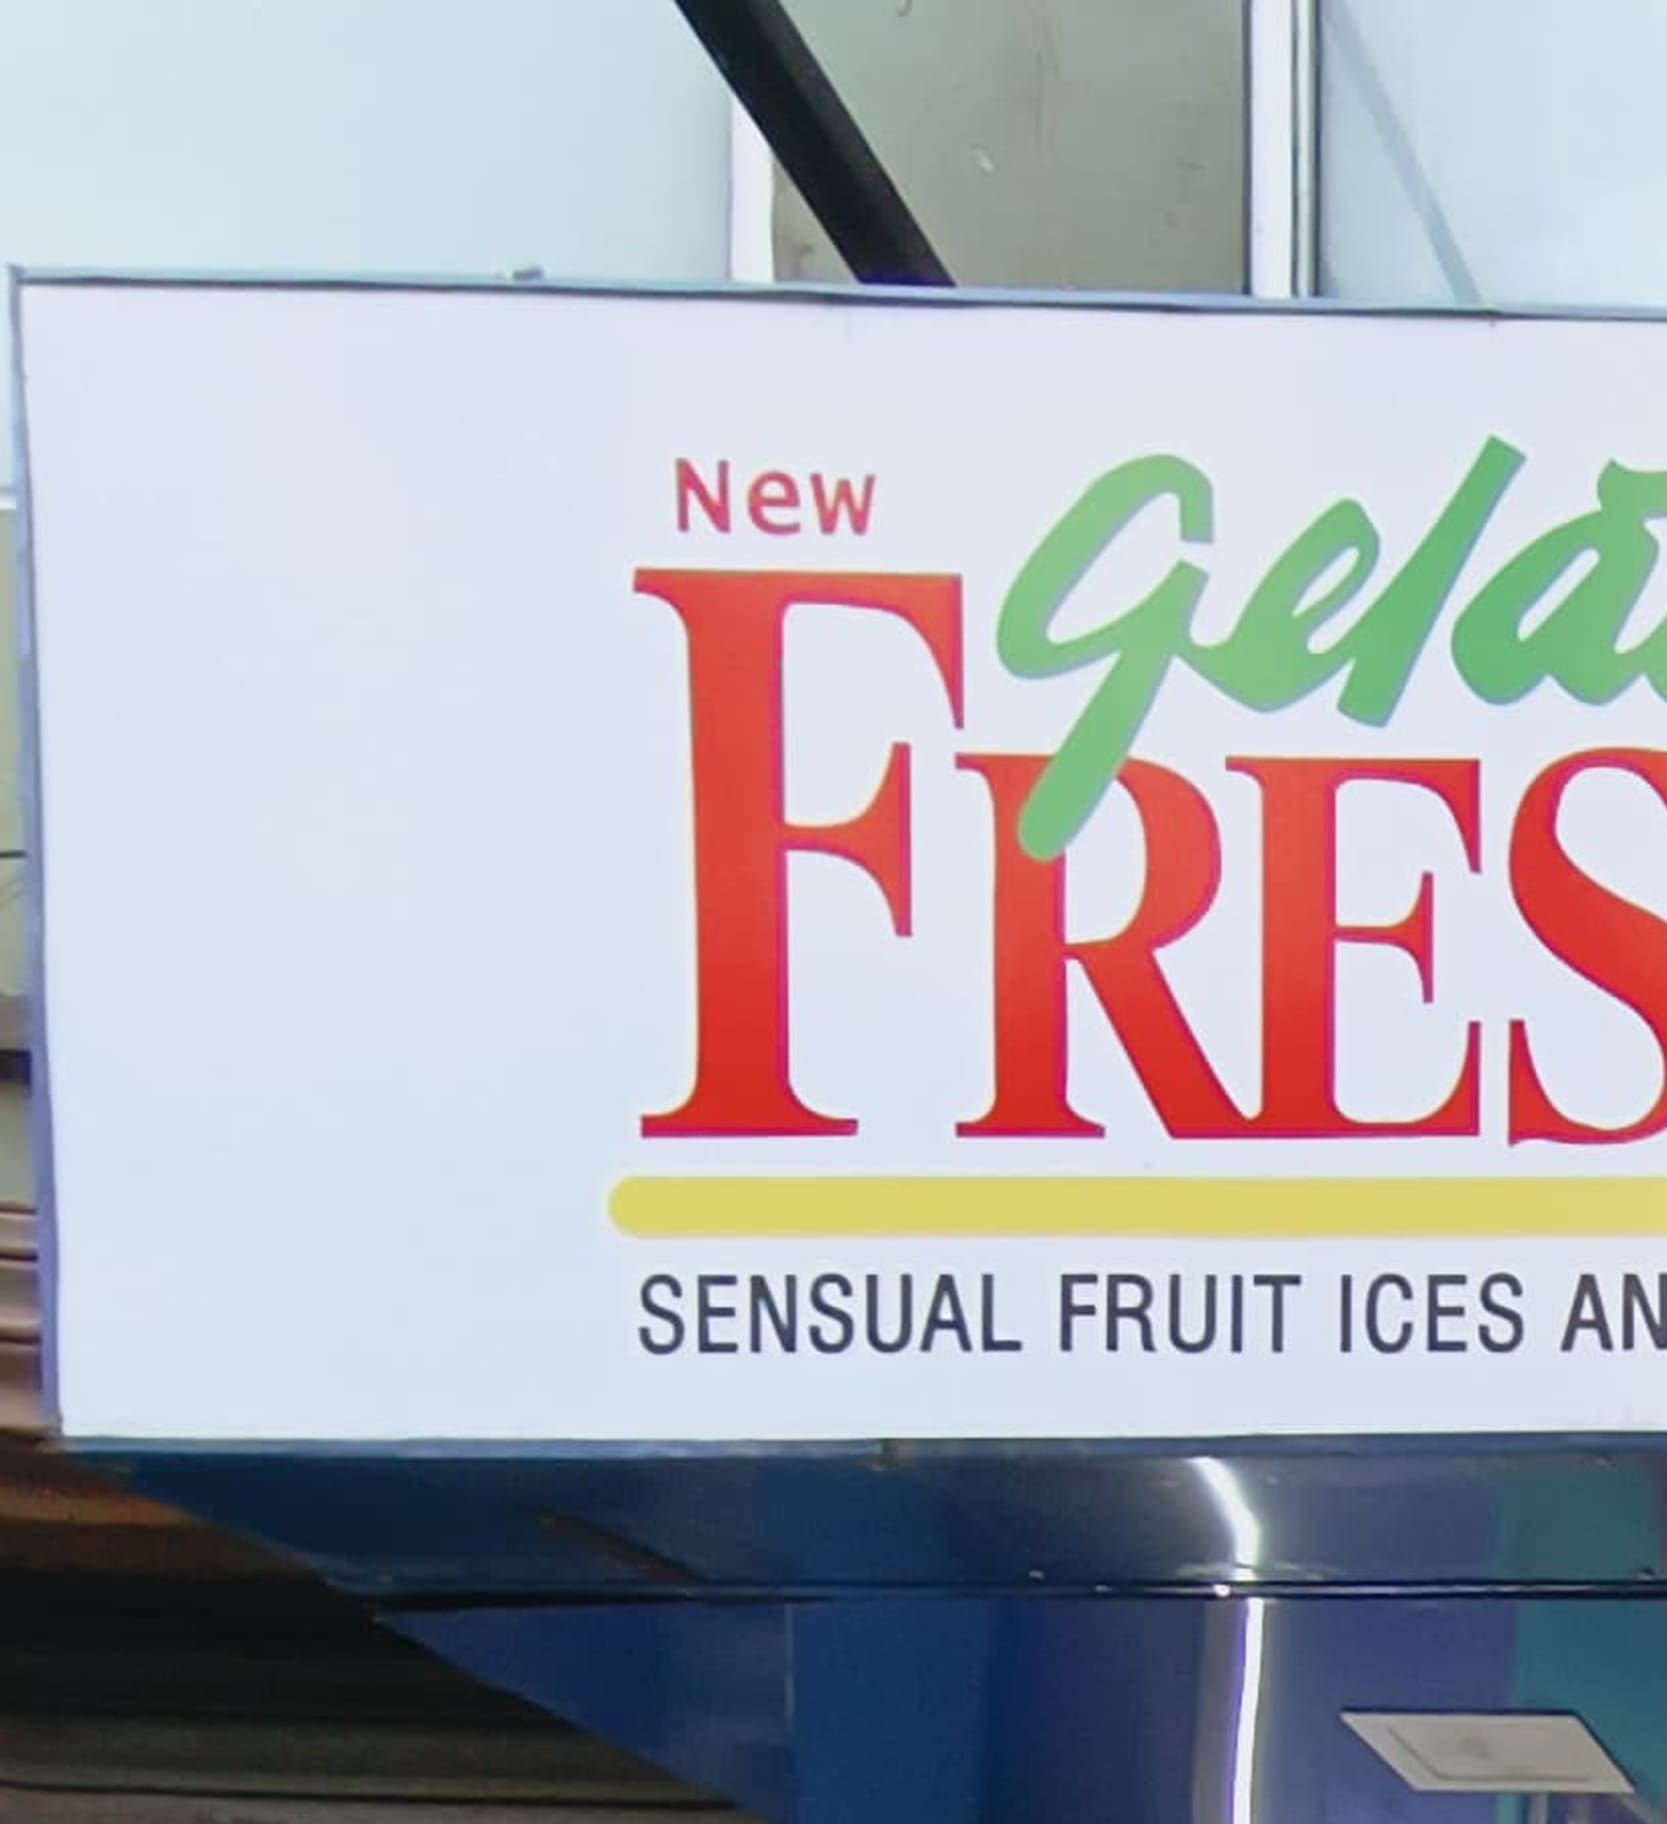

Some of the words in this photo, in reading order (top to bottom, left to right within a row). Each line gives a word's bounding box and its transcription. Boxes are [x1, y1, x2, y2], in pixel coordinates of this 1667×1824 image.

[674, 458, 877, 535] New
[639, 1273, 1022, 1355] SENSUAL
[1060, 1273, 1301, 1354] FRUIT
[1339, 1273, 1524, 1354] ICES
